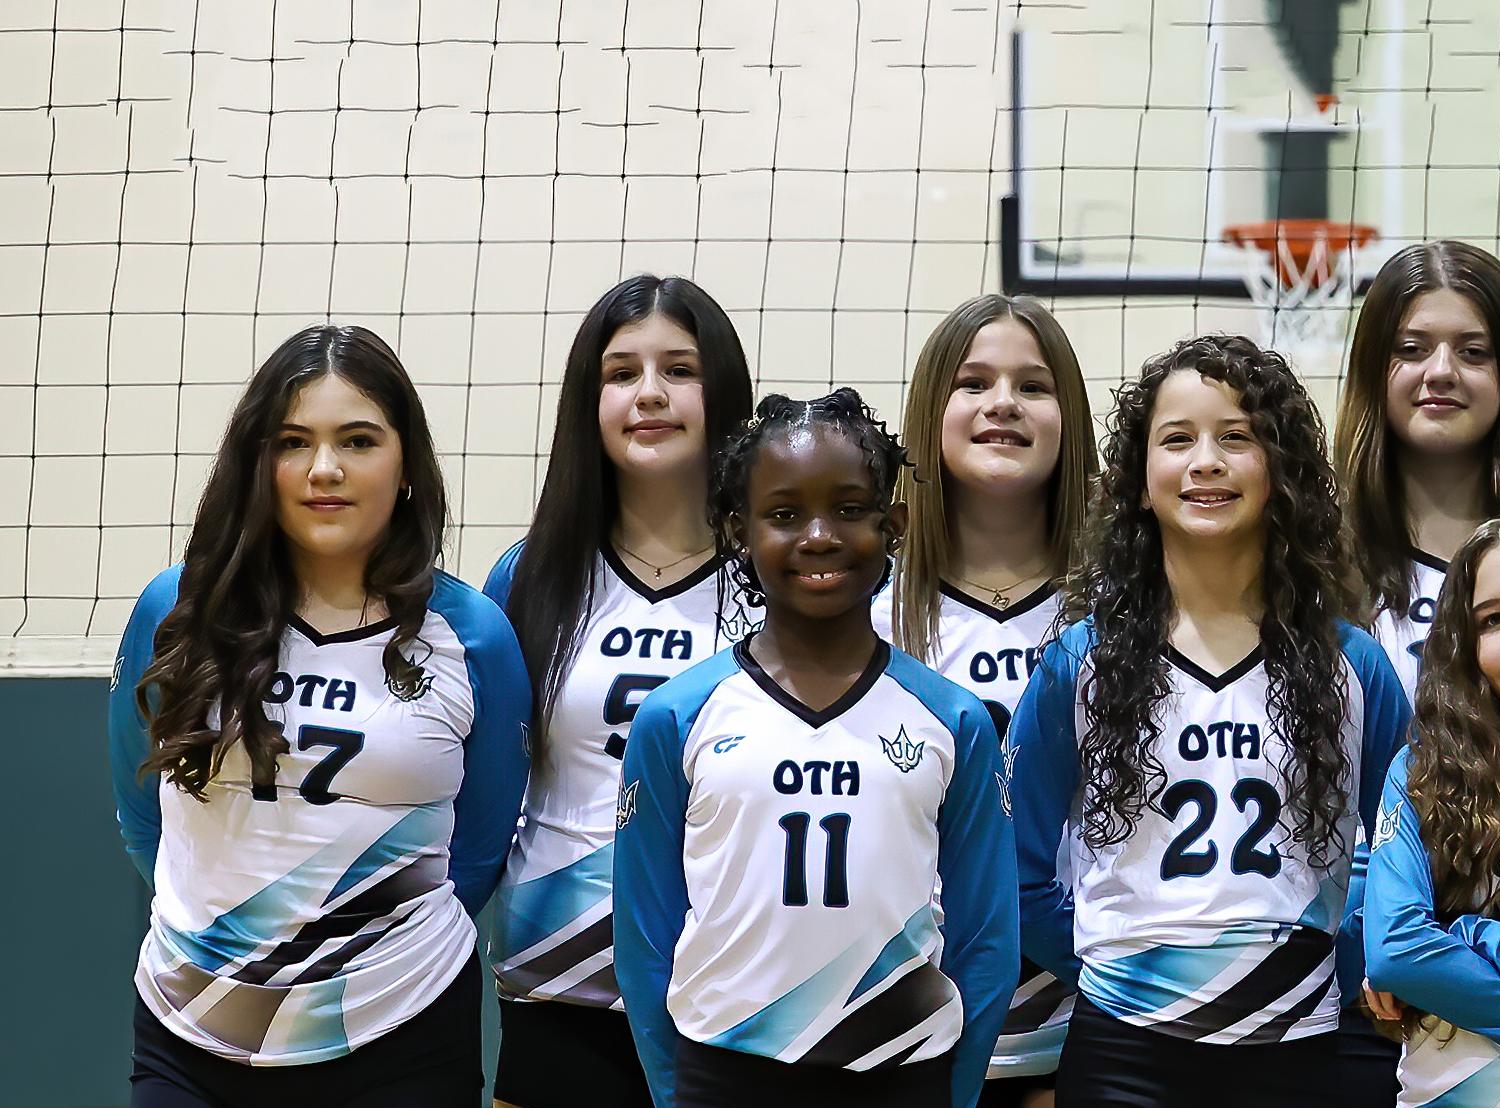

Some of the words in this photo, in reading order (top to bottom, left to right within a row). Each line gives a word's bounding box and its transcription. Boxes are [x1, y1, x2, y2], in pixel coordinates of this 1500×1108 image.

[600, 626, 693, 660] OTH
[262, 671, 357, 712] OTH
[1178, 720, 1261, 761] OTH
[772, 759, 861, 796] OTH
[1160, 777, 1283, 882] 22
[778, 811, 852, 908] 11
